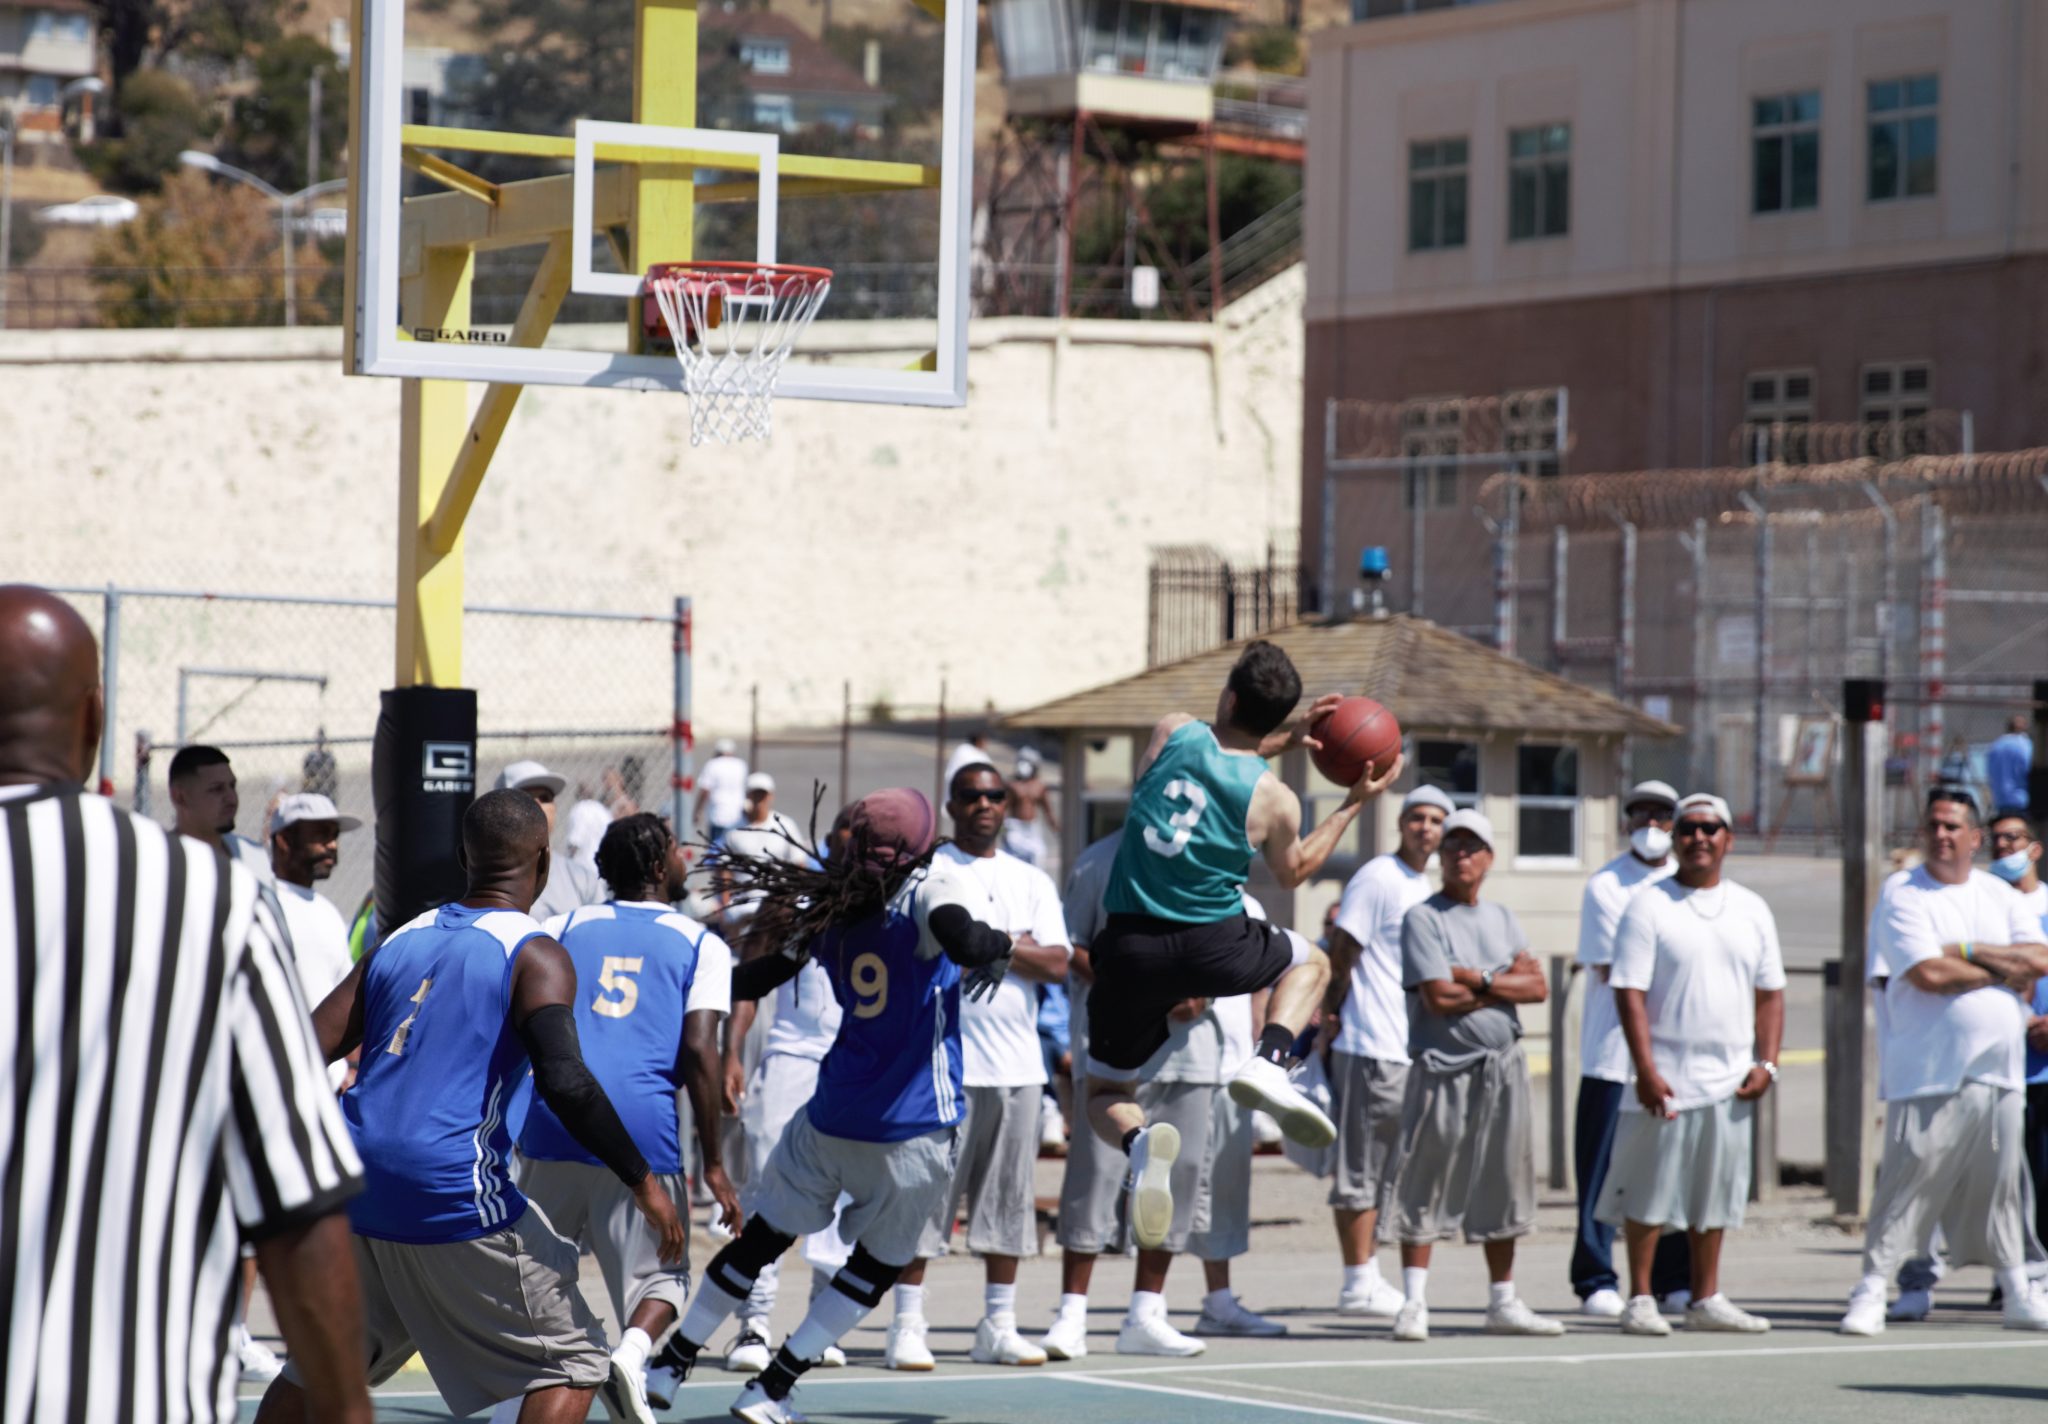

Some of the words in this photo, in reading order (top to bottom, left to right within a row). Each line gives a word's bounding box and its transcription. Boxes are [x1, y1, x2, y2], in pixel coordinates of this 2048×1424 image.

[438, 329, 506, 342] GARED
[1143, 779, 1208, 858] 3
[591, 955, 644, 1018] 5
[851, 952, 888, 1018] 9
